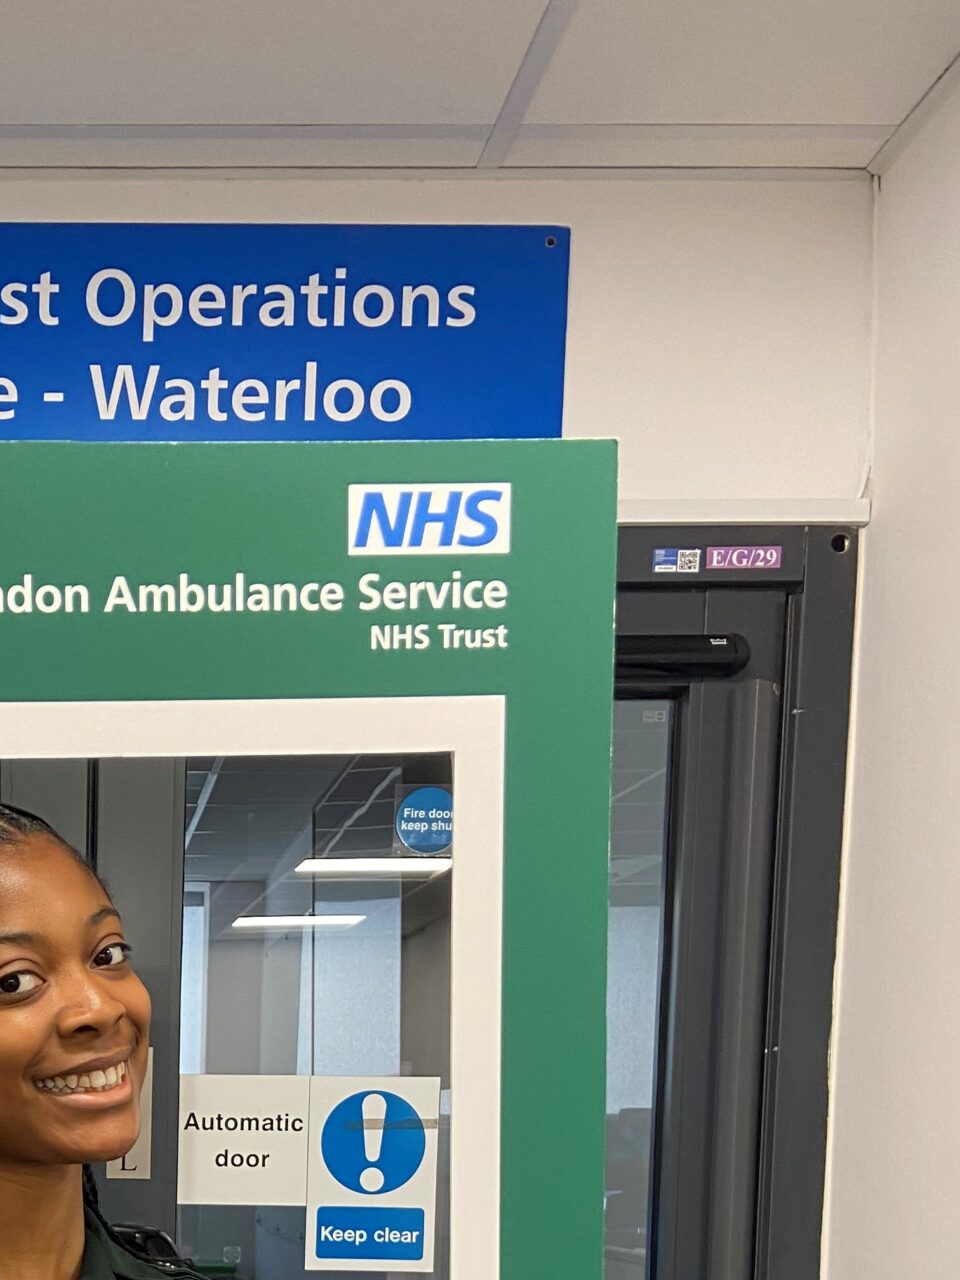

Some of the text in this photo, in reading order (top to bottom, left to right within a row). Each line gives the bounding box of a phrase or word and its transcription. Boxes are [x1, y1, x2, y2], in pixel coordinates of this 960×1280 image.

[85, 267, 477, 342] Operations
[43, 392, 64, 402] -
[89, 361, 412, 422] Waterloo
[352, 489, 503, 548] NHS
[711, 548, 778, 567] E/G/29
[104, 573, 344, 612] Ambulance
[358, 571, 508, 611] Service
[370, 624, 508, 650] NHS Trust
[403, 808, 425, 818] Fire
[401, 820, 428, 832] keep
[183, 1112, 304, 1132] Automatic
[215, 1149, 270, 1168] door
[320, 1225, 420, 1245] Keep clear
